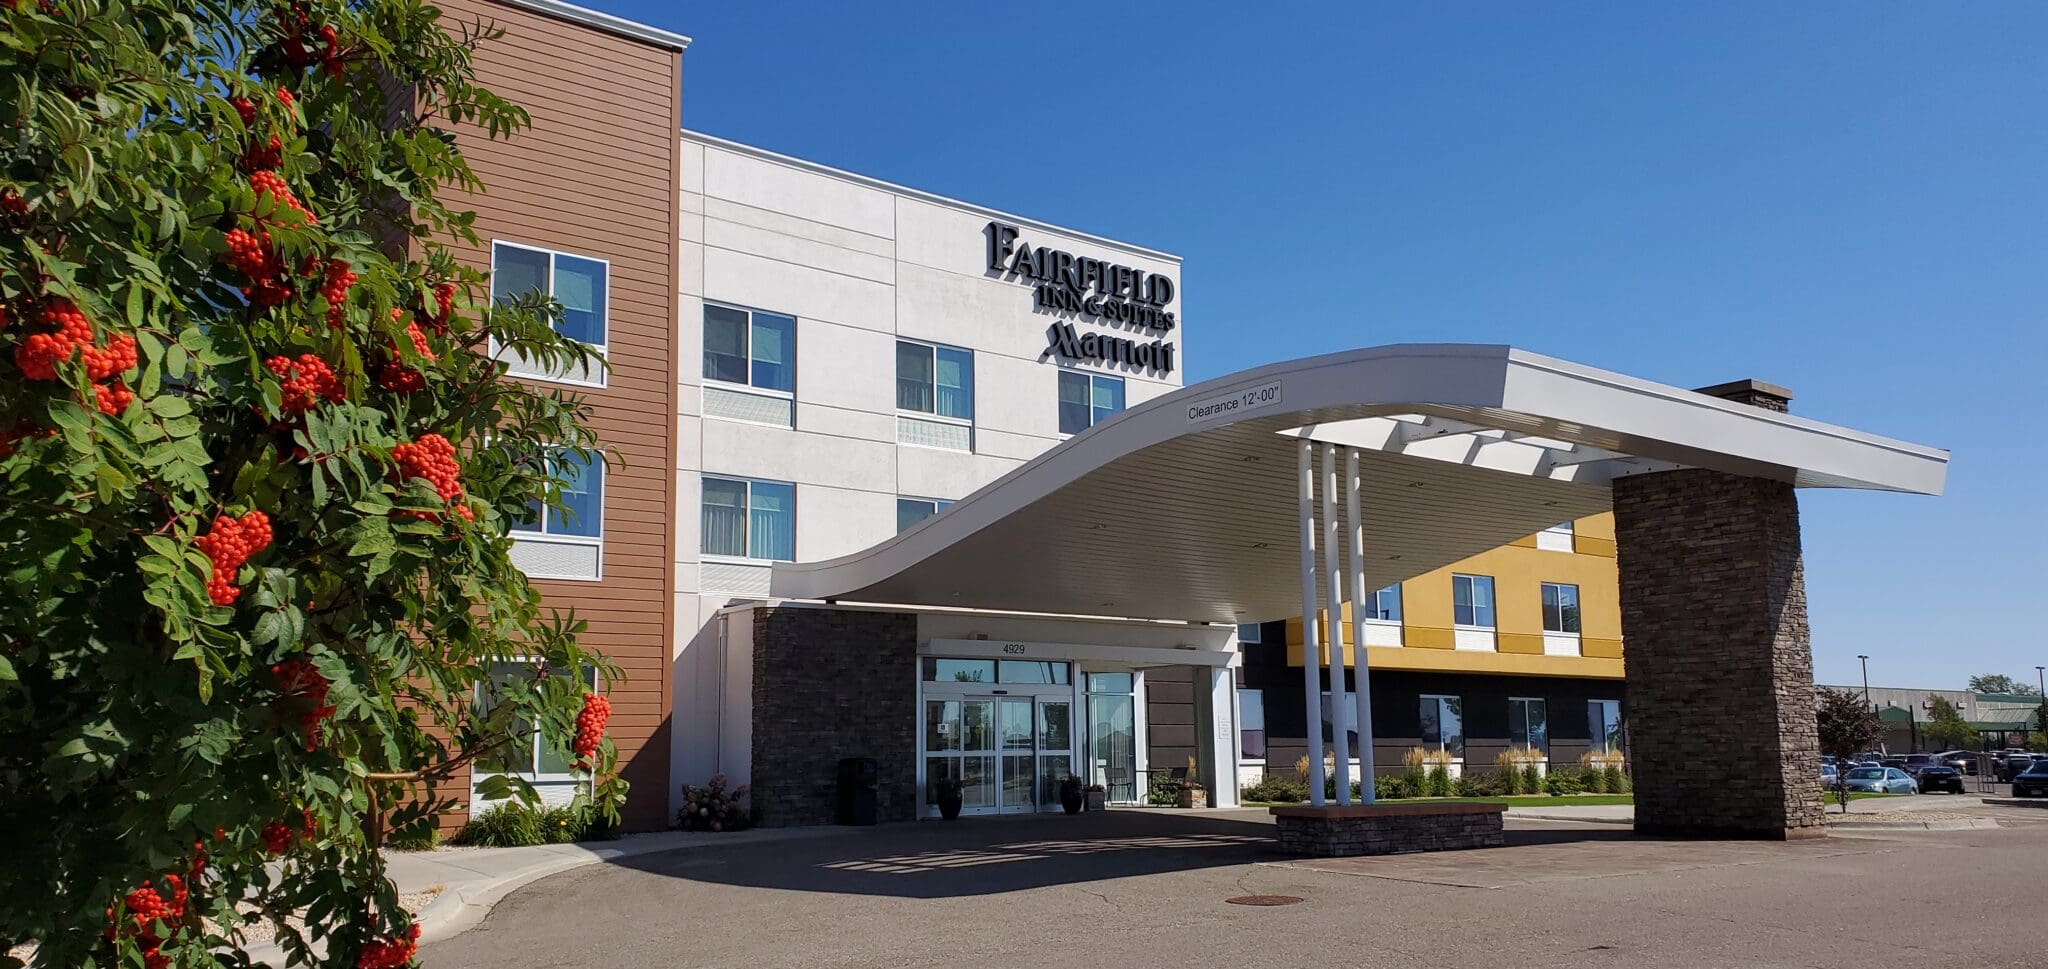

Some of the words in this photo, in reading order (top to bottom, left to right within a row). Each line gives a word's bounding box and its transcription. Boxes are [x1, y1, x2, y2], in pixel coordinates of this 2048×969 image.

[985, 221, 1174, 307] FAIRFIELD
[1036, 285, 1085, 314] INN
[1087, 296, 1104, 316] &
[1107, 299, 1175, 332] SUITES
[1039, 320, 1175, 373] Marriott
[1188, 399, 1239, 420] Clearance
[1003, 644, 1025, 654] 4929
